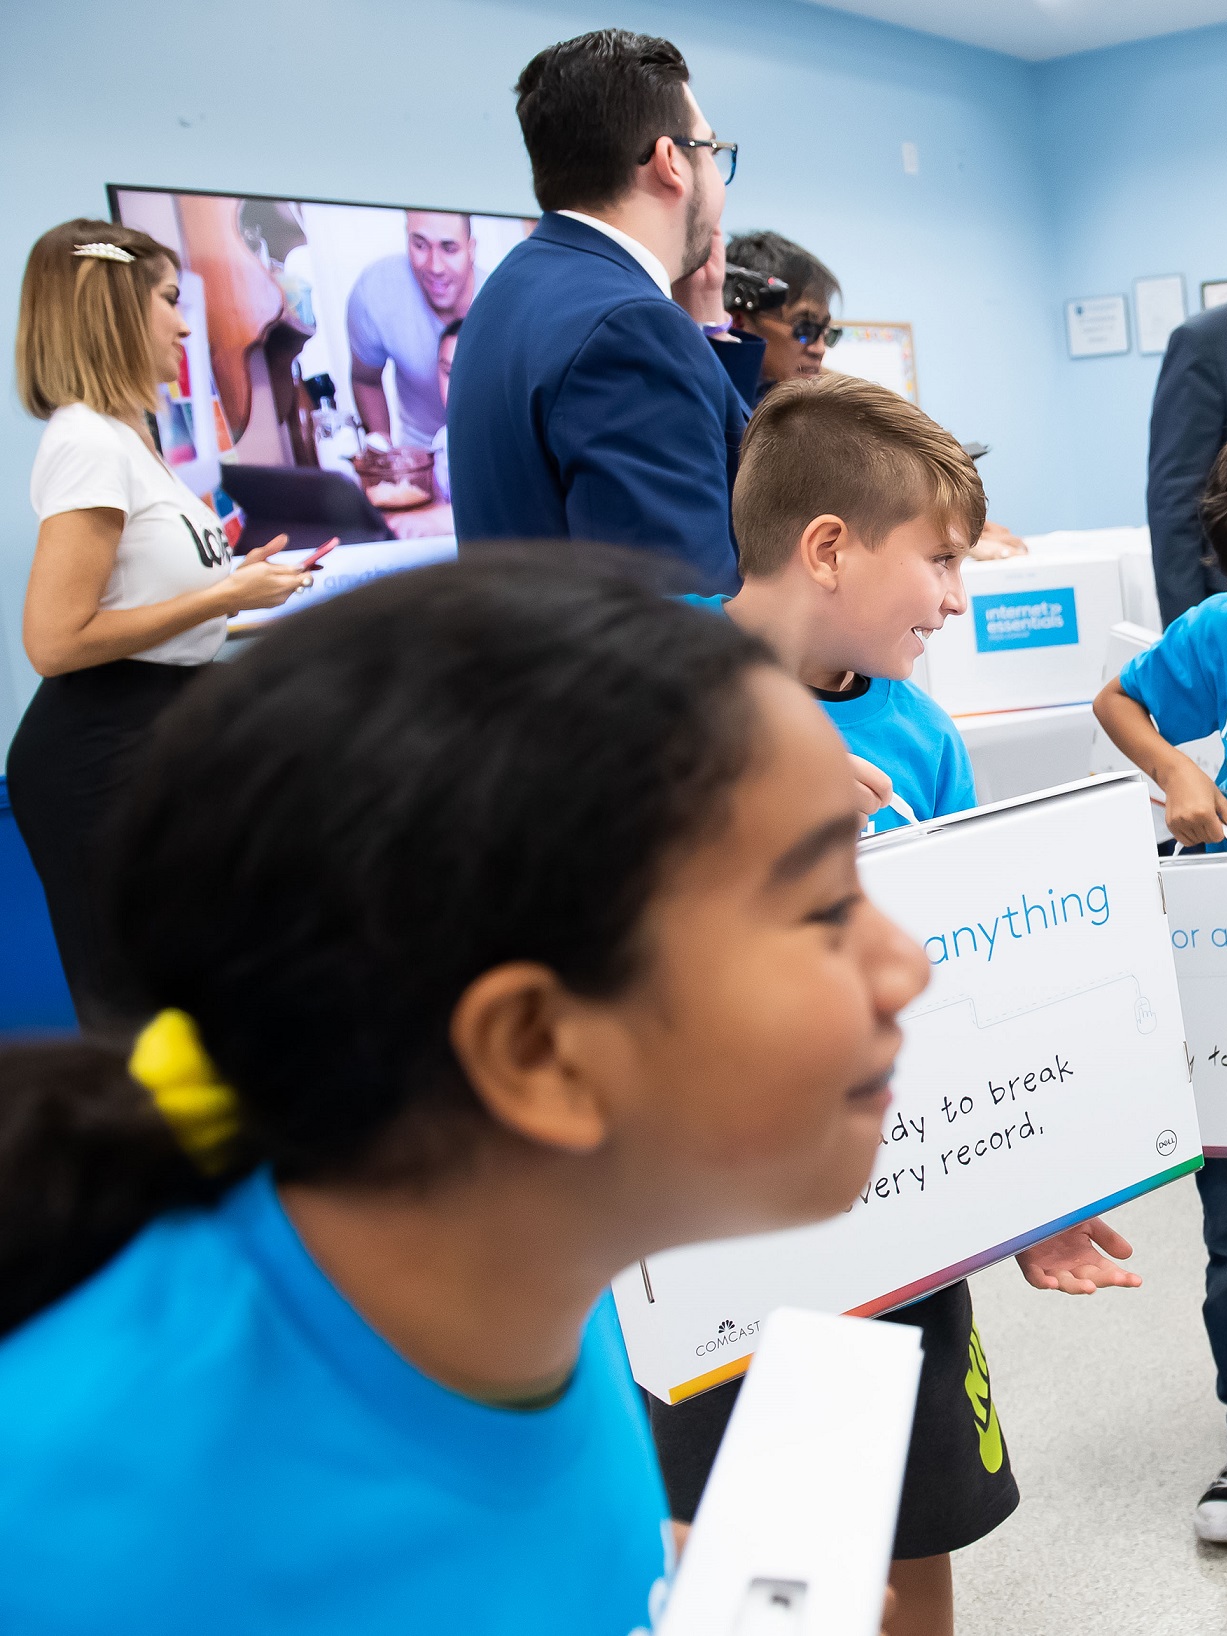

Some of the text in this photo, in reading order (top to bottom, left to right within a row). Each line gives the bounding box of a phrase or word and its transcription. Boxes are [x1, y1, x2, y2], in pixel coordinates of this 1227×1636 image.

[923, 884, 1110, 965] anything
[1171, 928, 1200, 949] or
[941, 1096, 974, 1123] to
[988, 1055, 1074, 1105] break
[1158, 1137, 1175, 1149] DELL
[695, 1319, 761, 1357] COMCAST
